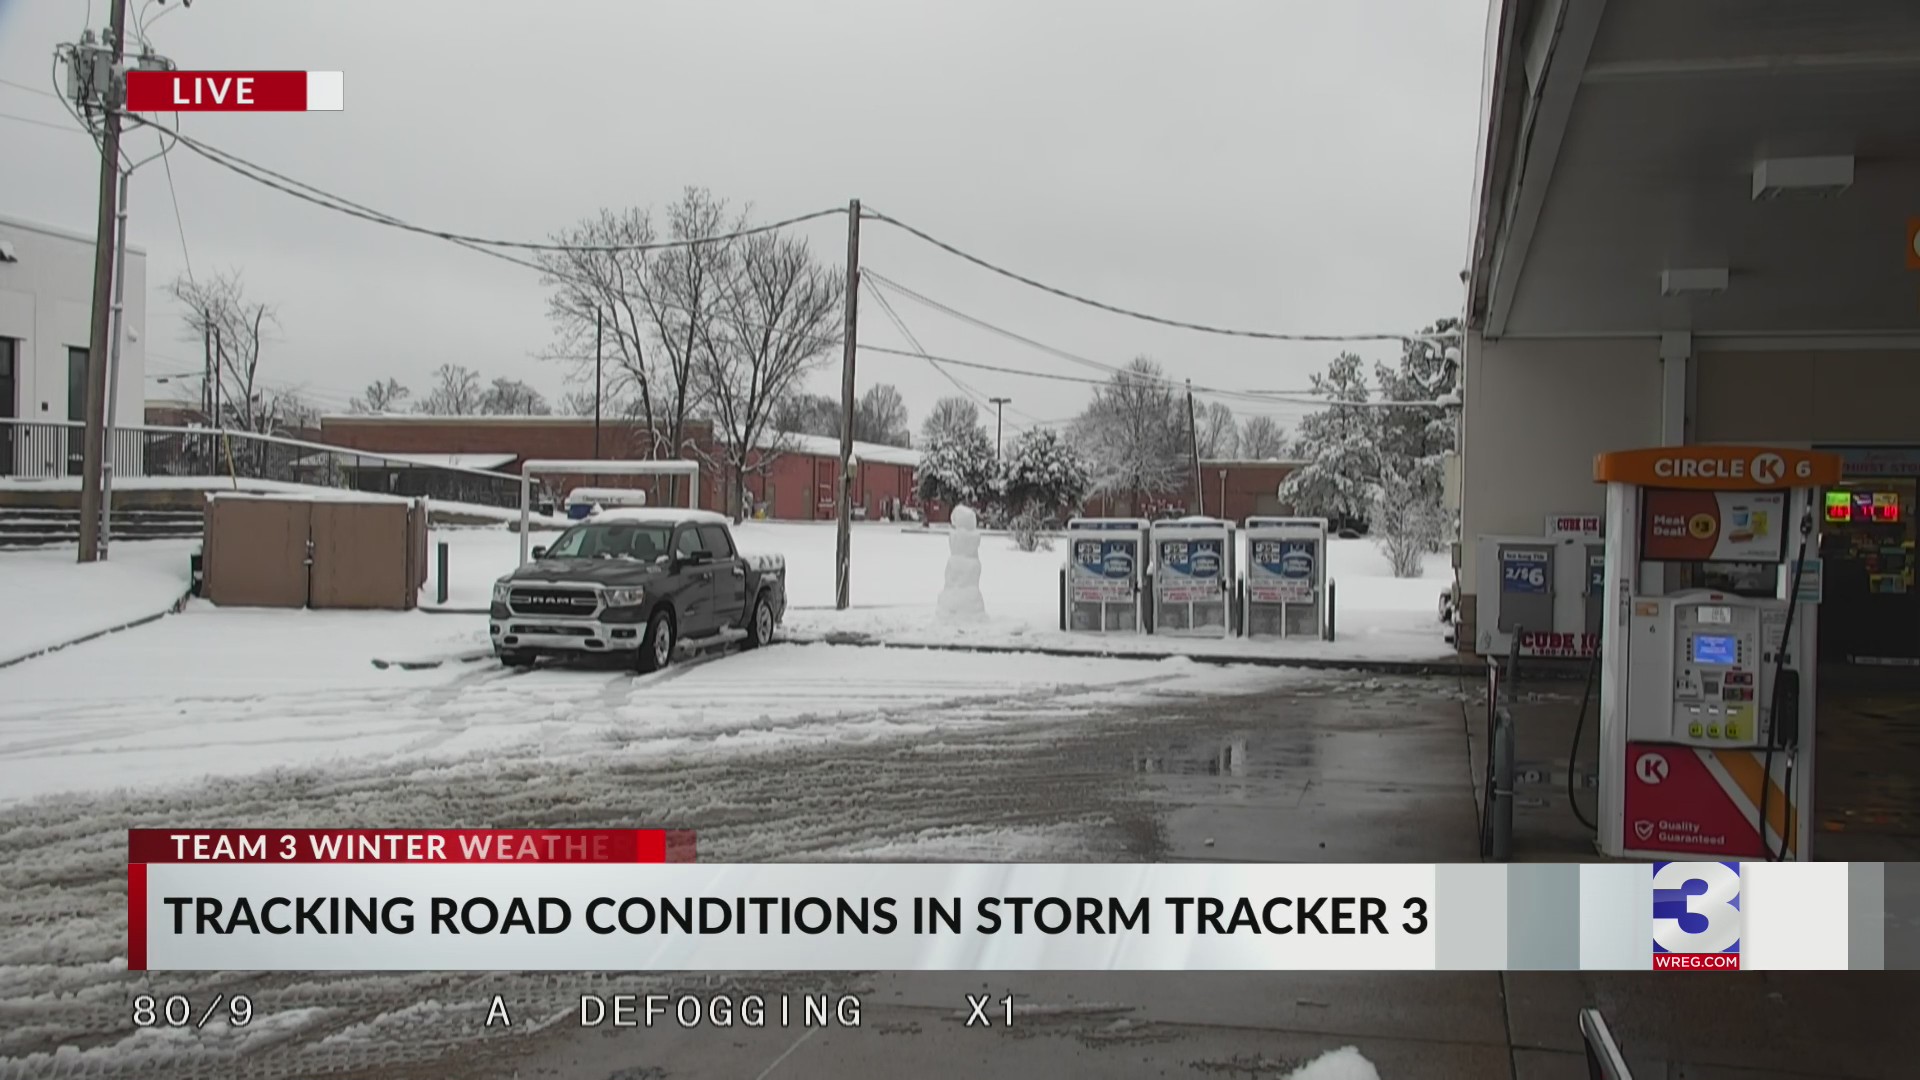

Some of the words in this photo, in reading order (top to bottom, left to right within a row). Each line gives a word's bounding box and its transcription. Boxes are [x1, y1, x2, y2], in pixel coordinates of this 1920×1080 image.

[1654, 458, 1744, 478] CIRCLE
[1756, 456, 1781, 482] K
[1796, 460, 1811, 478] 6
[1557, 518, 1581, 532] CUBE
[1582, 518, 1598, 532] ICE
[1653, 515, 1685, 526] Meal
[1653, 526, 1687, 537] Deal!
[1505, 567, 1544, 586] 2/$6
[533, 596, 570, 605] RAM
[1521, 632, 1575, 650] CUBE
[1580, 633, 1599, 650] IC
[1641, 756, 1668, 784] K
[1659, 820, 1700, 833] Quality
[1659, 832, 1726, 845] Guaranteed
